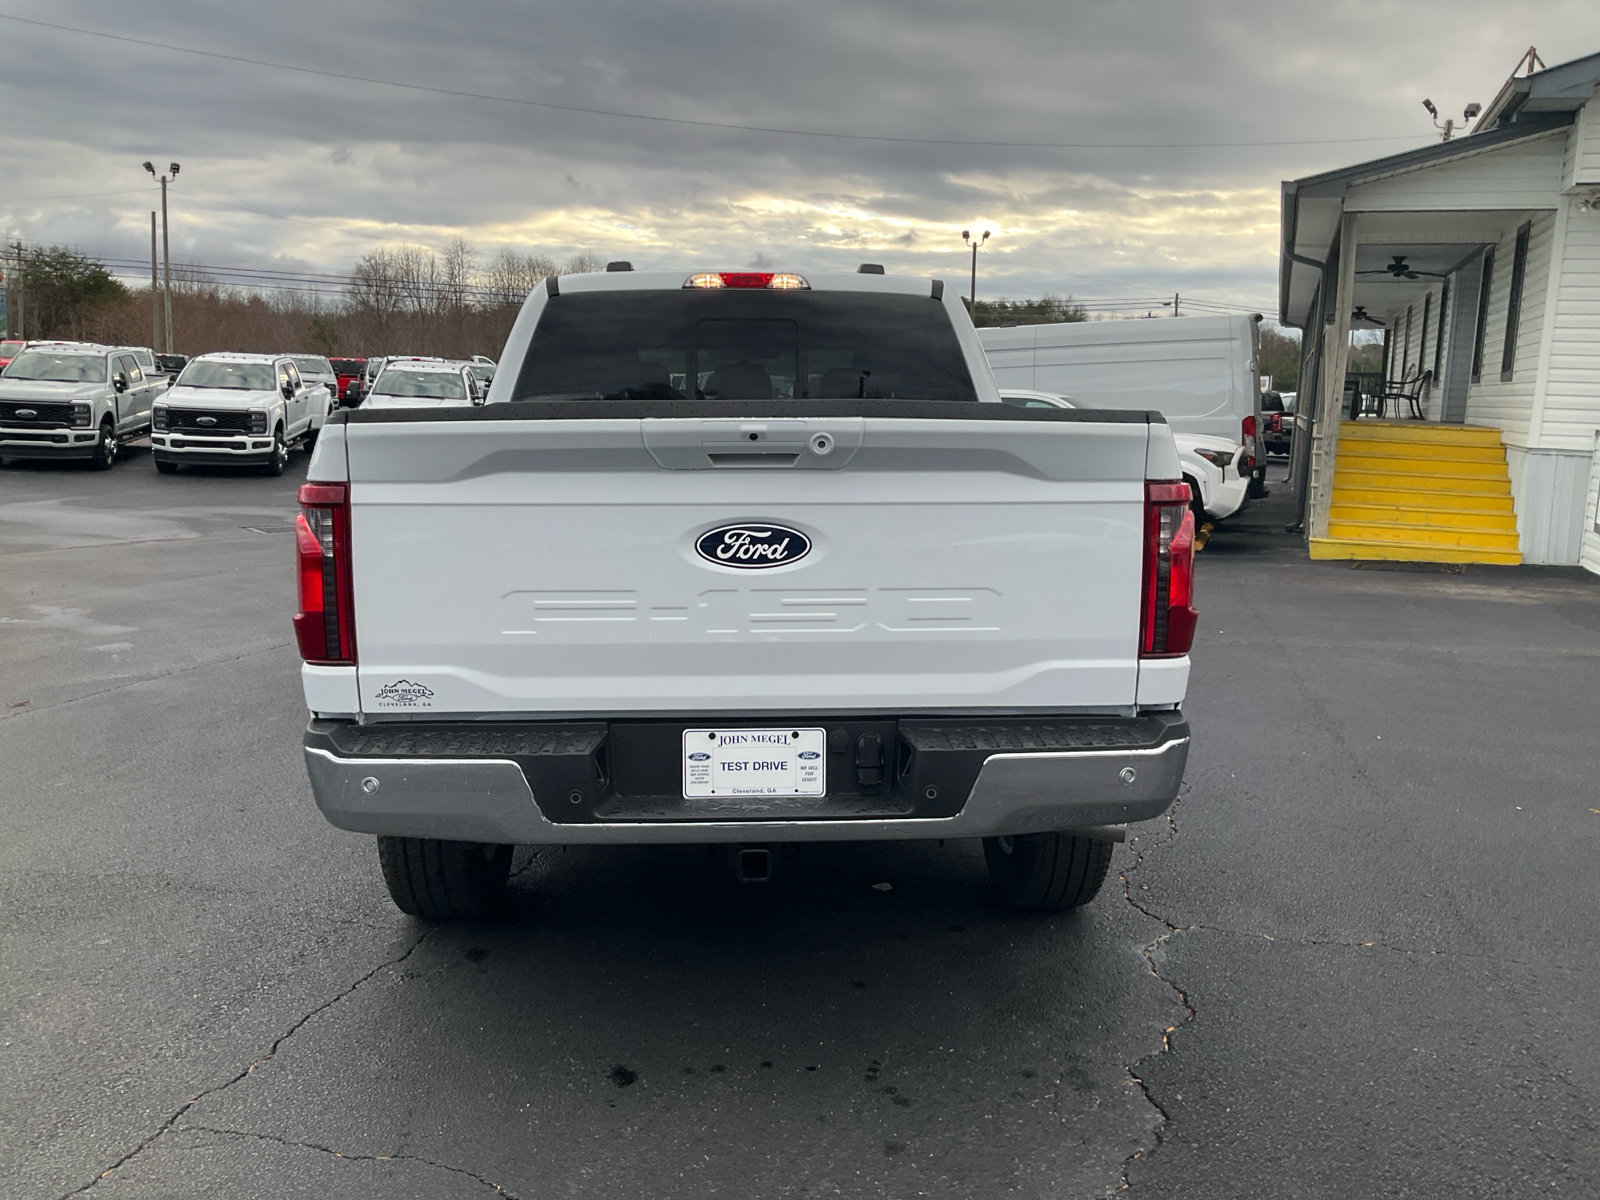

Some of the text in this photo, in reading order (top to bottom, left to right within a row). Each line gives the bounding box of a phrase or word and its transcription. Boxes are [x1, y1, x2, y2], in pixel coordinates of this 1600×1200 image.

[716, 529, 790, 560] Ford
[718, 735, 791, 747] JOHN MEGEL
[720, 762, 749, 771] TEST
[752, 761, 788, 771] DRIVE
